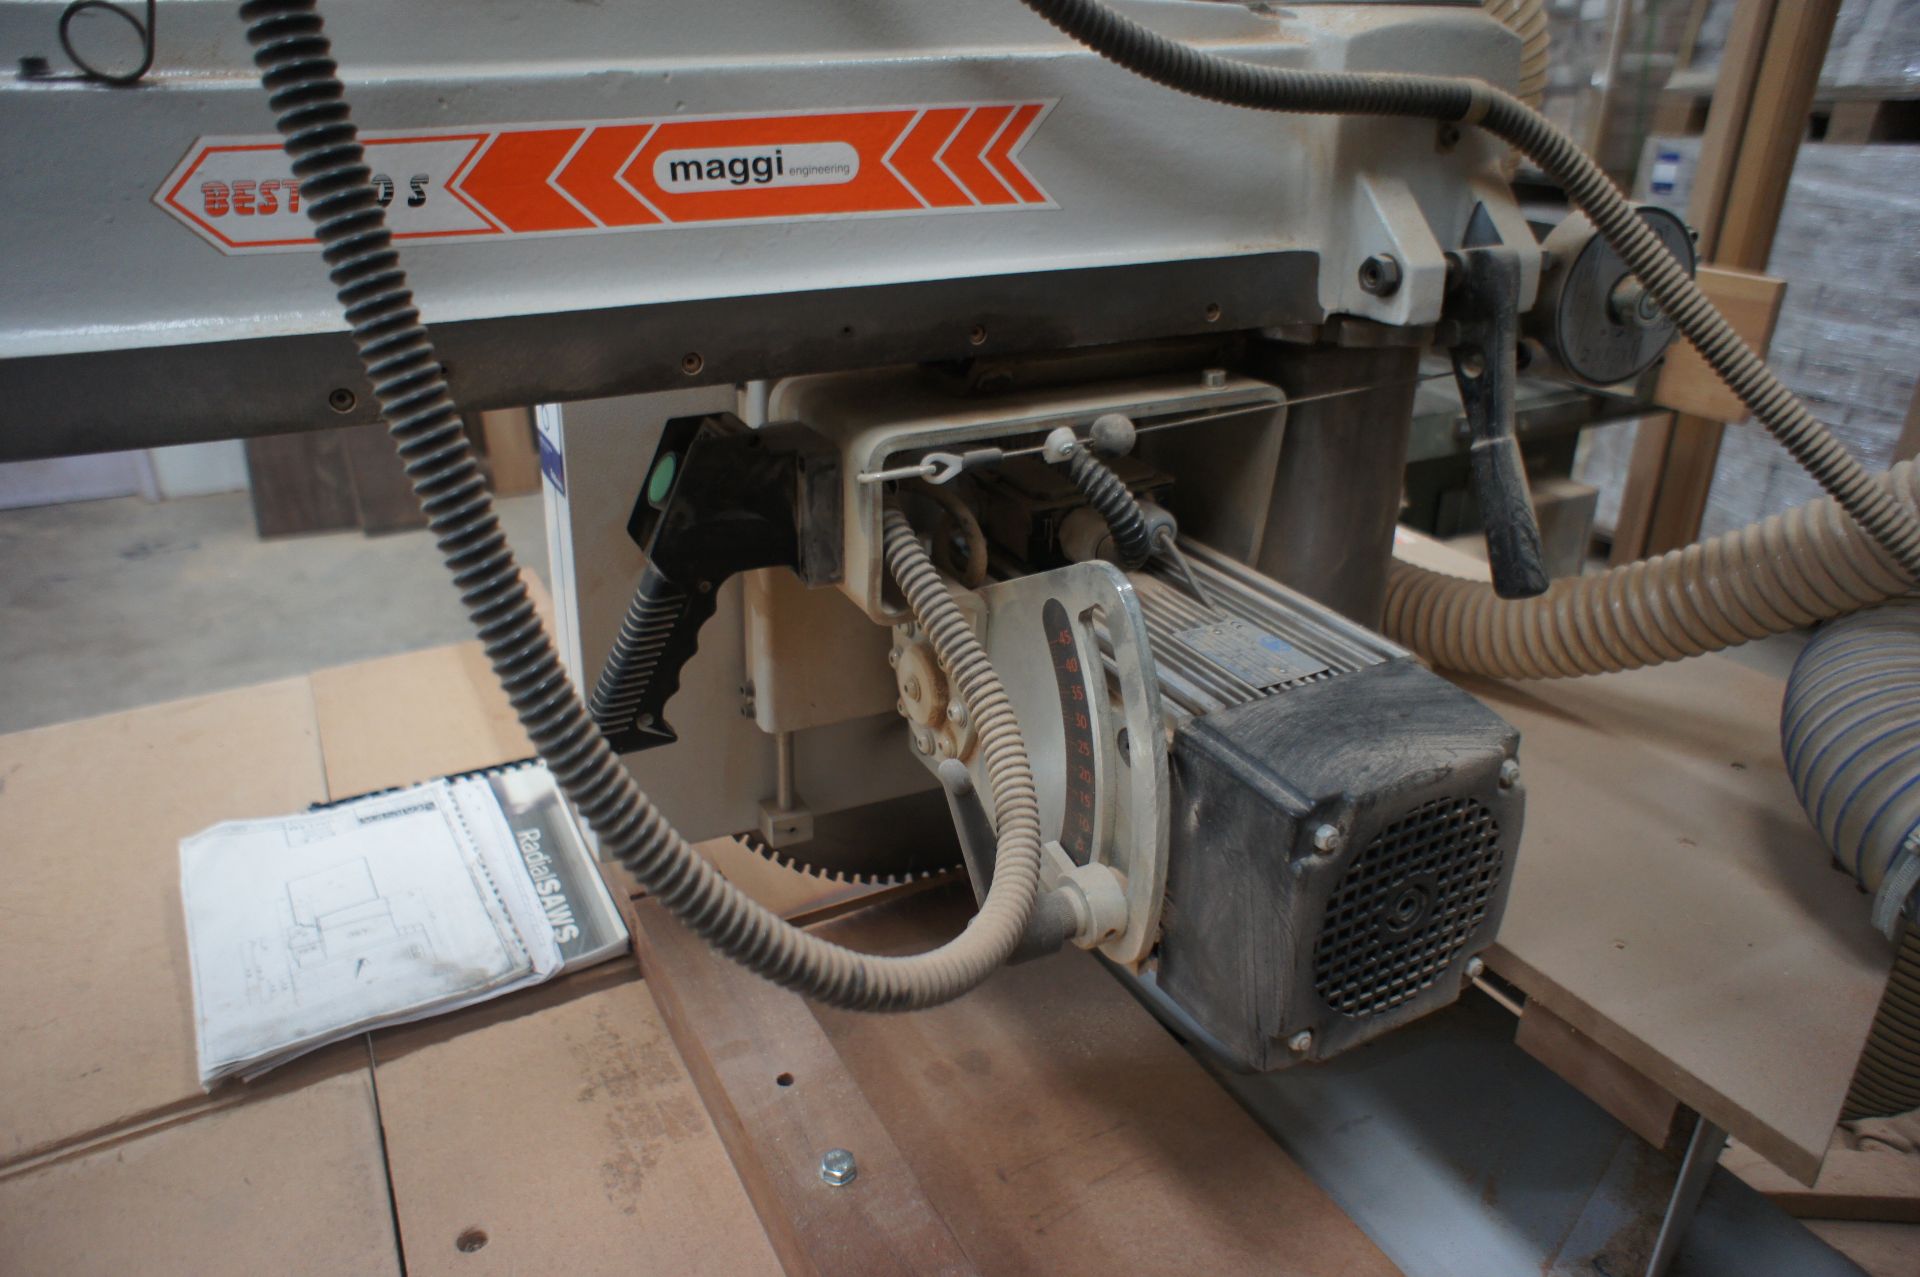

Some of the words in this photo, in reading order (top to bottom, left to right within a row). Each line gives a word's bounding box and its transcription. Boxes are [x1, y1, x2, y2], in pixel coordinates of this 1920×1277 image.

[670, 149, 784, 186] maggi
[789, 161, 851, 177] engineering
[201, 180, 301, 217] BEST
[1058, 628, 1073, 645] 45
[1065, 656, 1078, 673] 40
[1071, 684, 1083, 700] 35
[1075, 711, 1088, 729] 30
